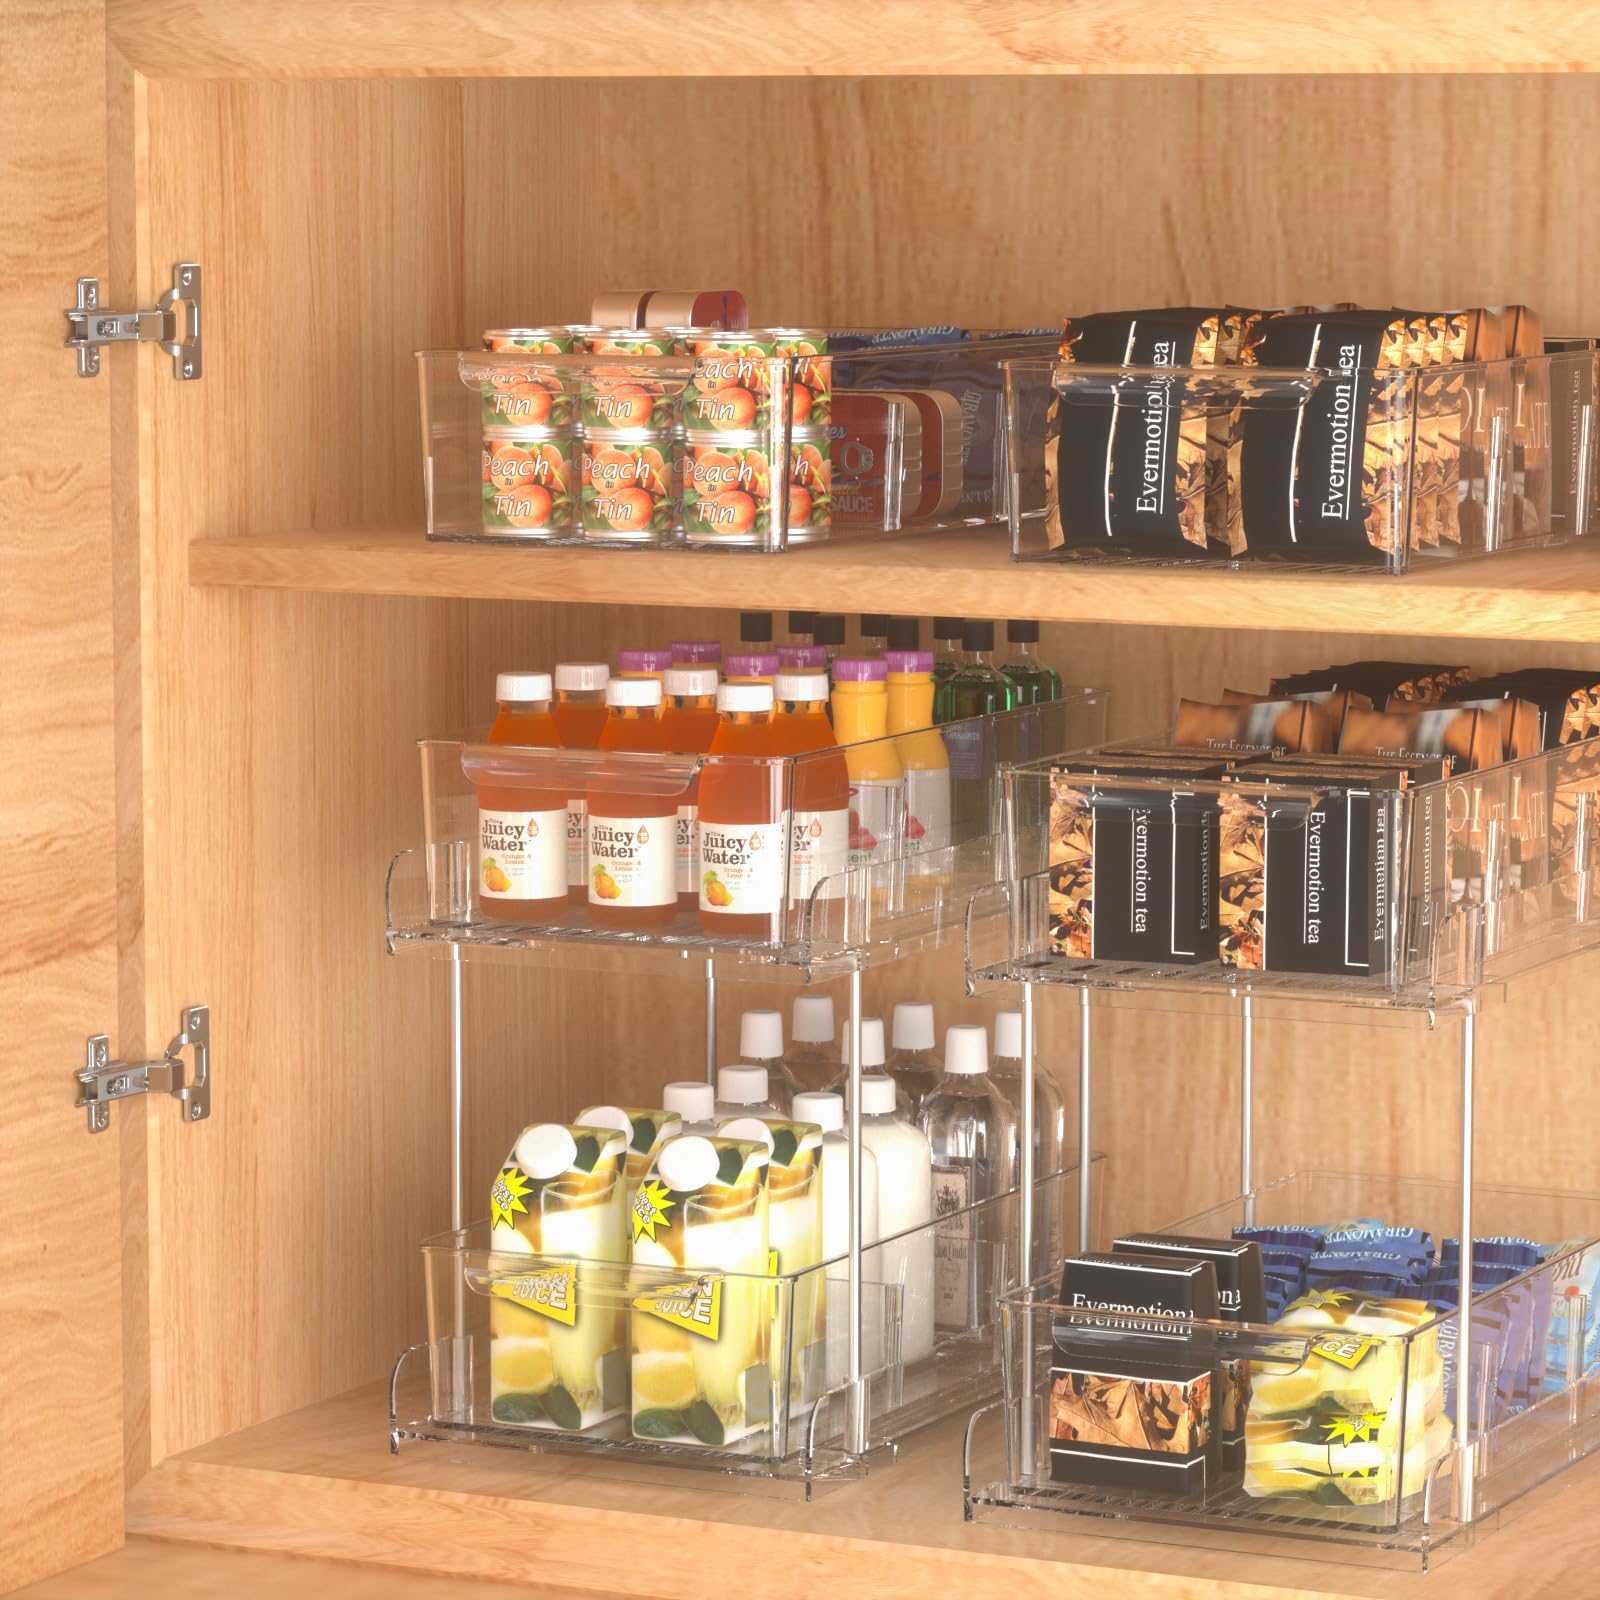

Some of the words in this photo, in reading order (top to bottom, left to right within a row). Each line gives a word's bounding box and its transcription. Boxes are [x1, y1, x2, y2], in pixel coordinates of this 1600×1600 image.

[693, 356, 754, 379] each
[492, 393, 532, 416] Tin
[593, 395, 633, 418] Tin
[695, 397, 736, 420] Tin
[1321, 384, 1351, 520] Evermotion
[483, 454, 549, 477] Peach
[582, 457, 650, 480] Peach
[684, 460, 754, 482] Peach
[492, 495, 532, 517] Tin
[593, 497, 633, 520] Tin
[696, 501, 736, 524] Tin
[482, 819, 526, 840] Juicy
[1377, 808, 1385, 833] tea
[481, 835, 527, 851] Water
[591, 825, 635, 846] Juicy
[703, 832, 748, 853] Juicy
[591, 841, 638, 858] Water
[702, 848, 750, 865] Water
[1308, 810, 1326, 914] Evermotion
[1200, 829, 1209, 929] Evermotion
[1422, 827, 1431, 926] Evermotion
[1374, 838, 1385, 942] Evermotion
[1135, 906, 1149, 933] tea
[1308, 918, 1322, 945] tea
[497, 1179, 515, 1204] best
[639, 1191, 656, 1217] best
[1324, 1226, 1414, 1244] GIRAMONTE
